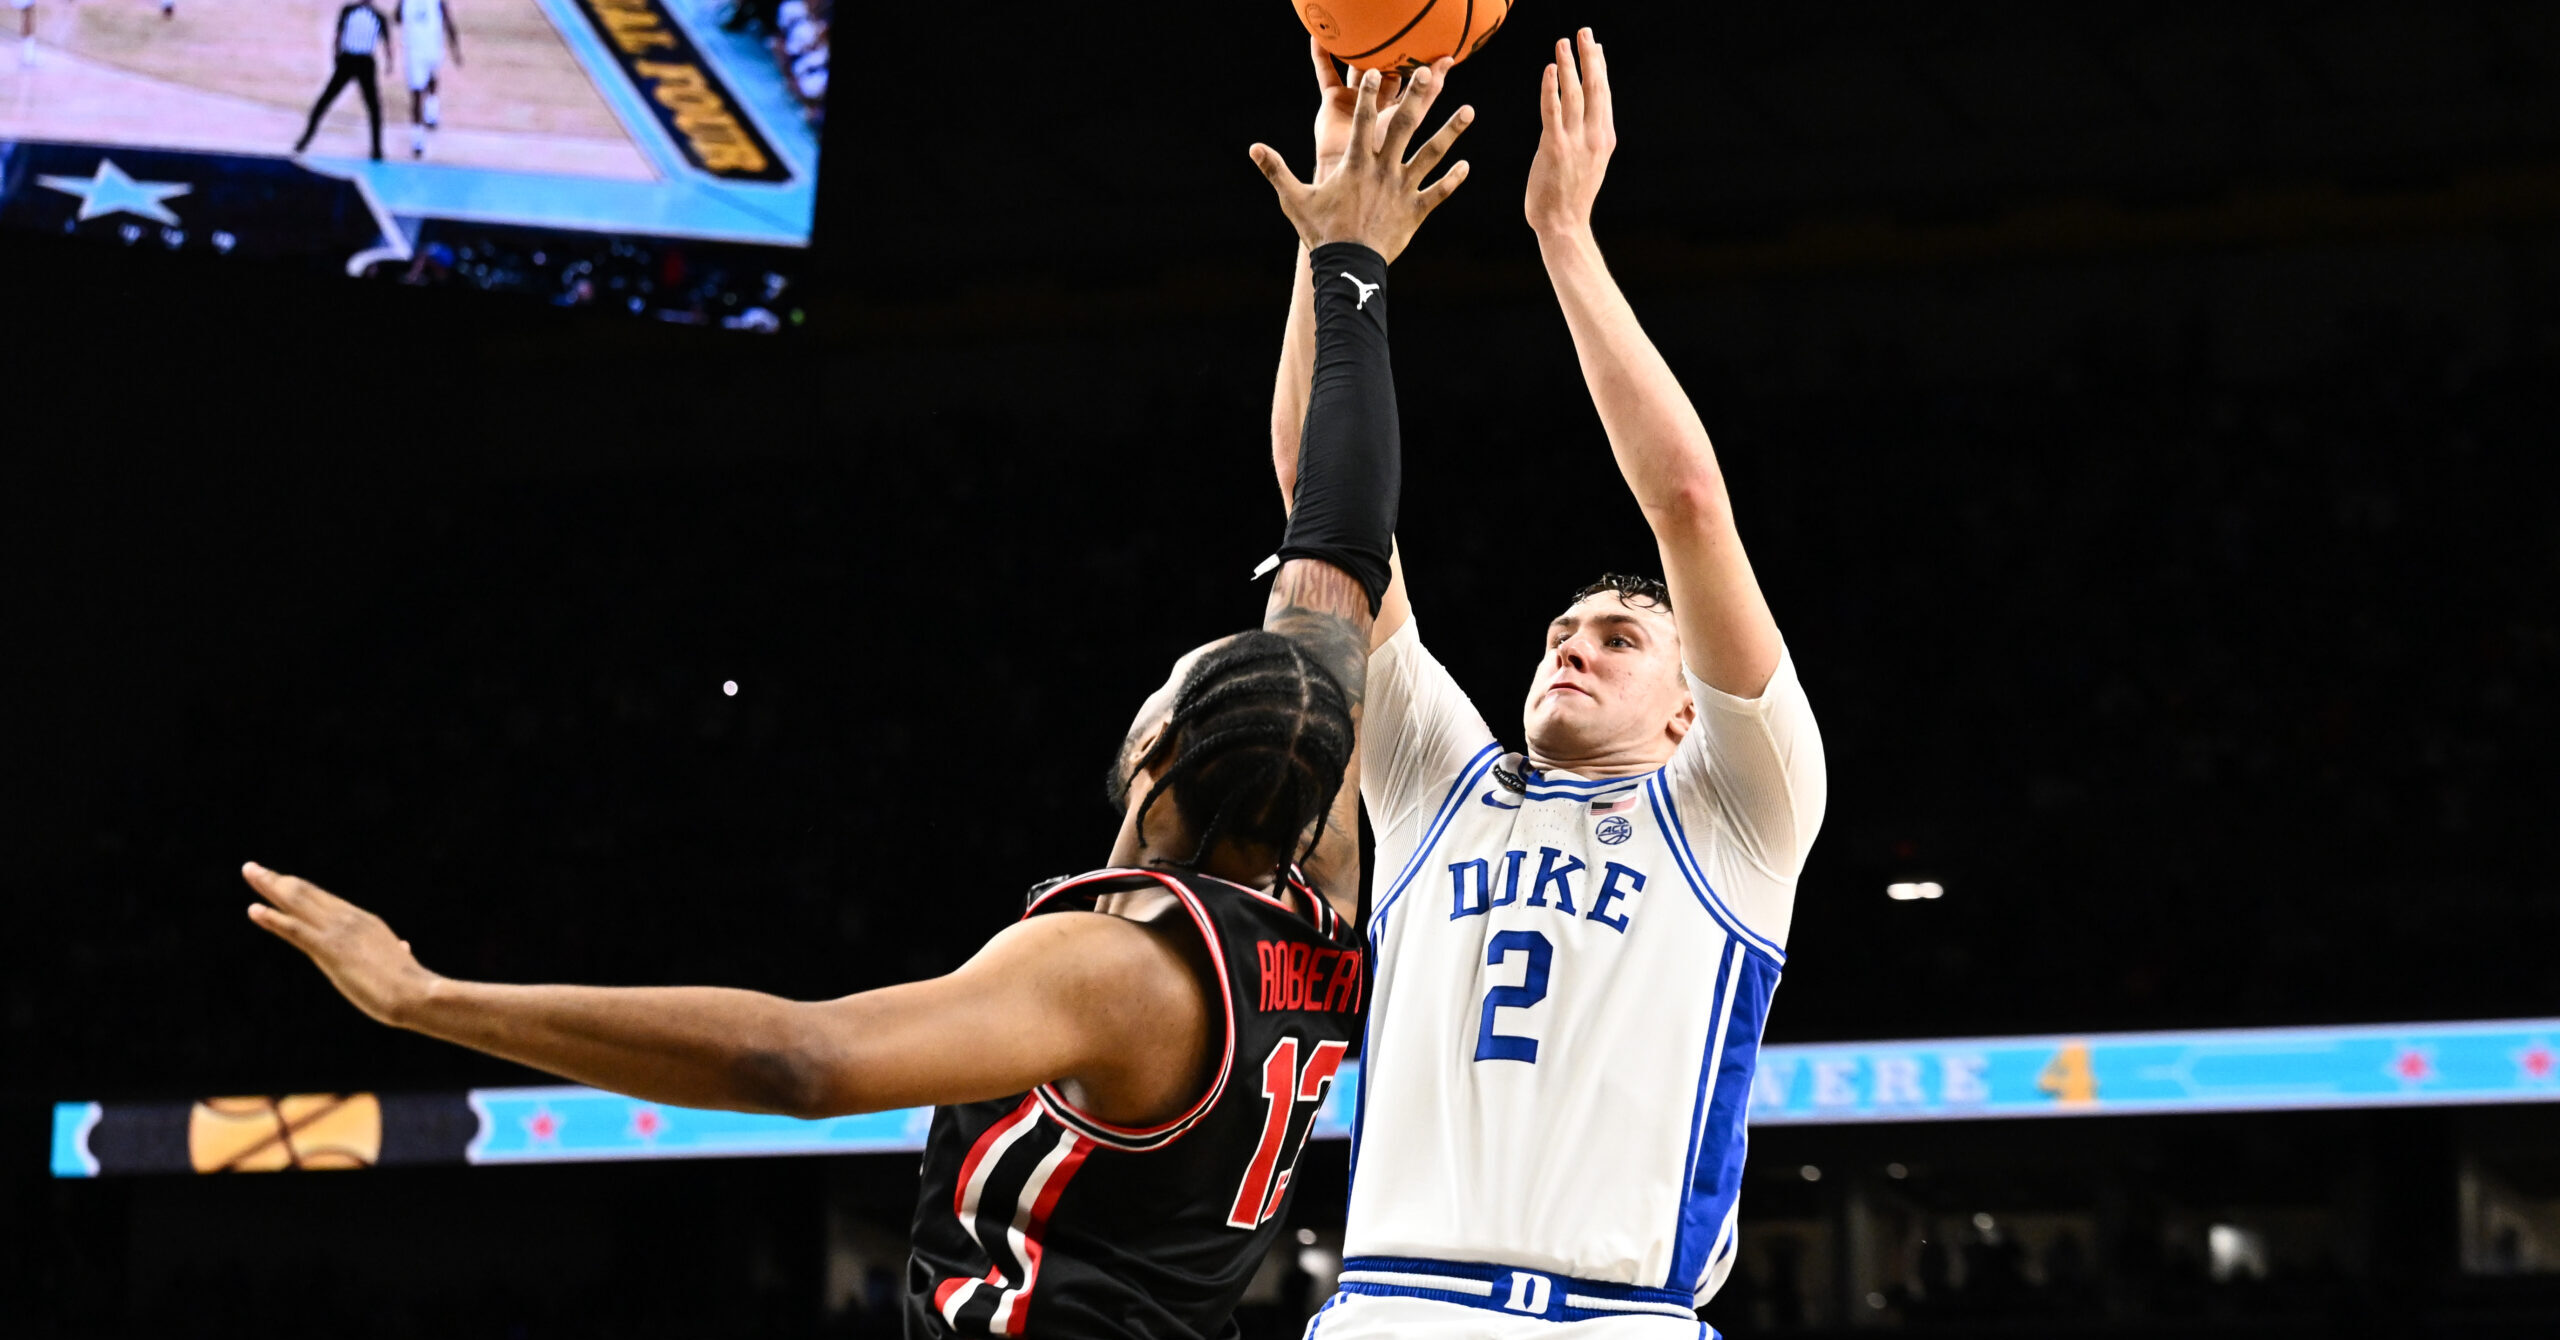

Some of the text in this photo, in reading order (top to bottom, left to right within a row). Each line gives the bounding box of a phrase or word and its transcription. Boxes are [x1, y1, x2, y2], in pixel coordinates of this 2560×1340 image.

[635, 61, 768, 173] FOUR
[1448, 846, 1647, 934] DUKE
[1256, 939, 1363, 1014] ROBER
[1473, 930, 1553, 1064] 2
[2038, 1041, 2096, 1108] 4
[1504, 1271, 1551, 1315] D
